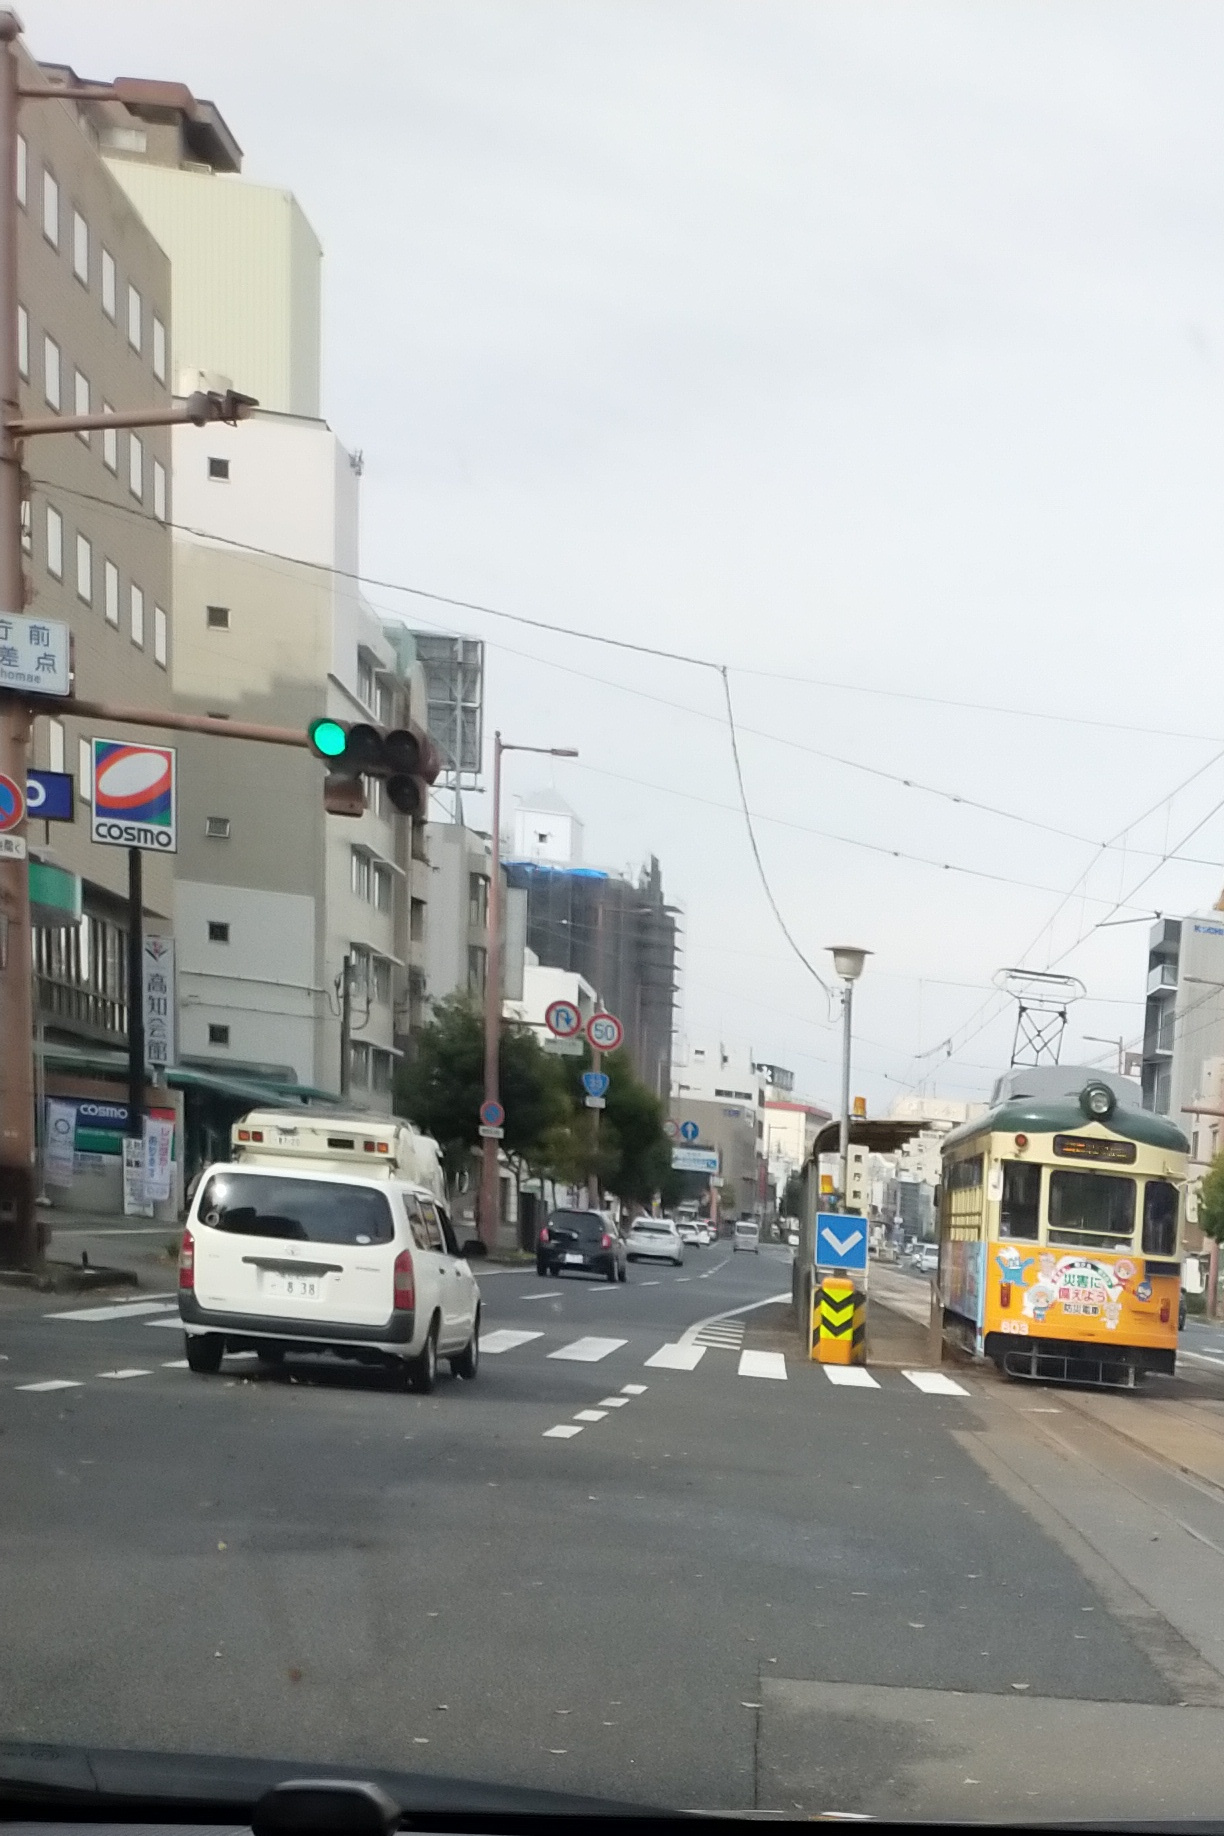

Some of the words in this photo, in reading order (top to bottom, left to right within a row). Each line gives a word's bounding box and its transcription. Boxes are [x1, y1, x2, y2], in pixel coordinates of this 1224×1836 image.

[95, 822, 172, 848] COSMO
[147, 972, 167, 1061] 高知会館
[594, 1022, 615, 1041] 50
[80, 1103, 128, 1119] COSMO
